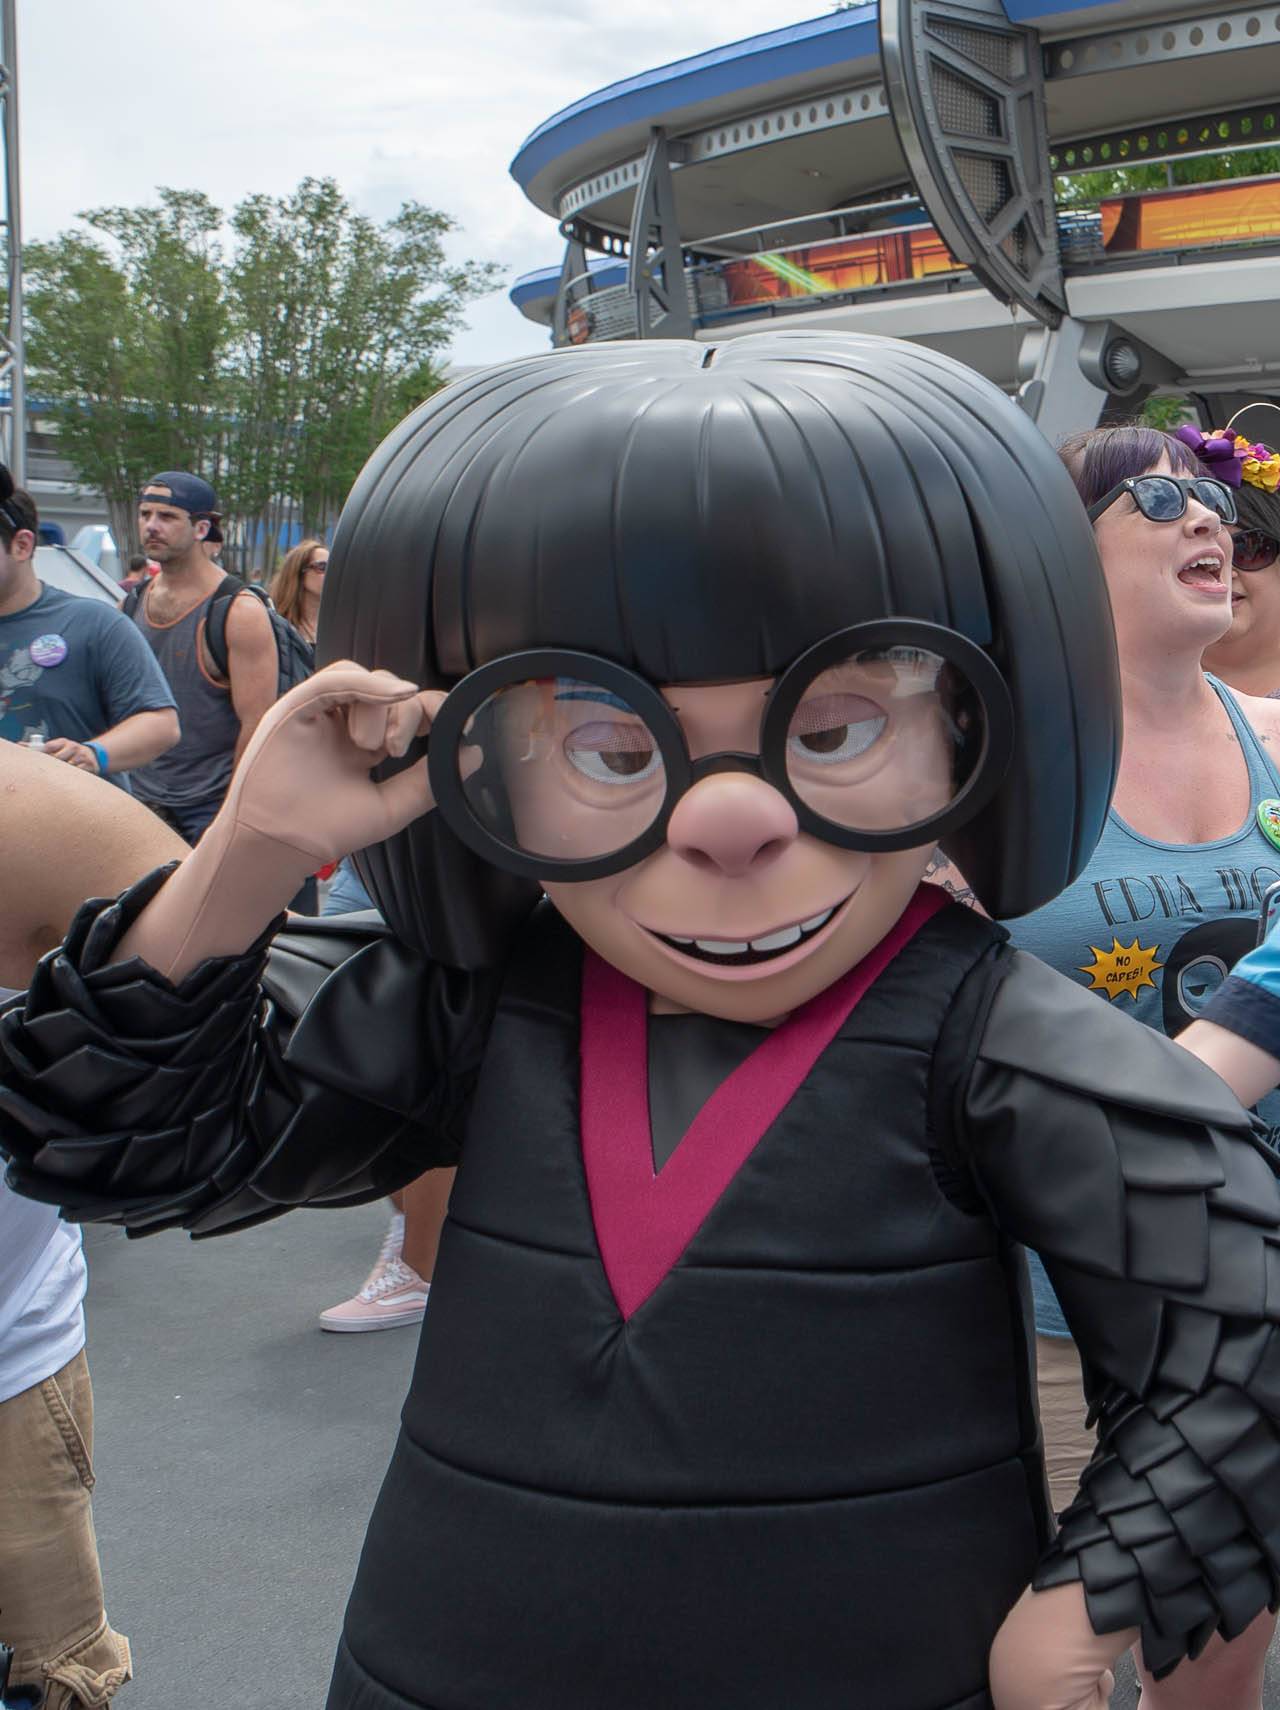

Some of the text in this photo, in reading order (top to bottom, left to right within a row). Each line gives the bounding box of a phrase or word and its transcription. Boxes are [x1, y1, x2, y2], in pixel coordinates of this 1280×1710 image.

[1091, 874, 1204, 927] EDNA
[1115, 955, 1131, 967] NO
[1105, 965, 1144, 983] CAPES!
